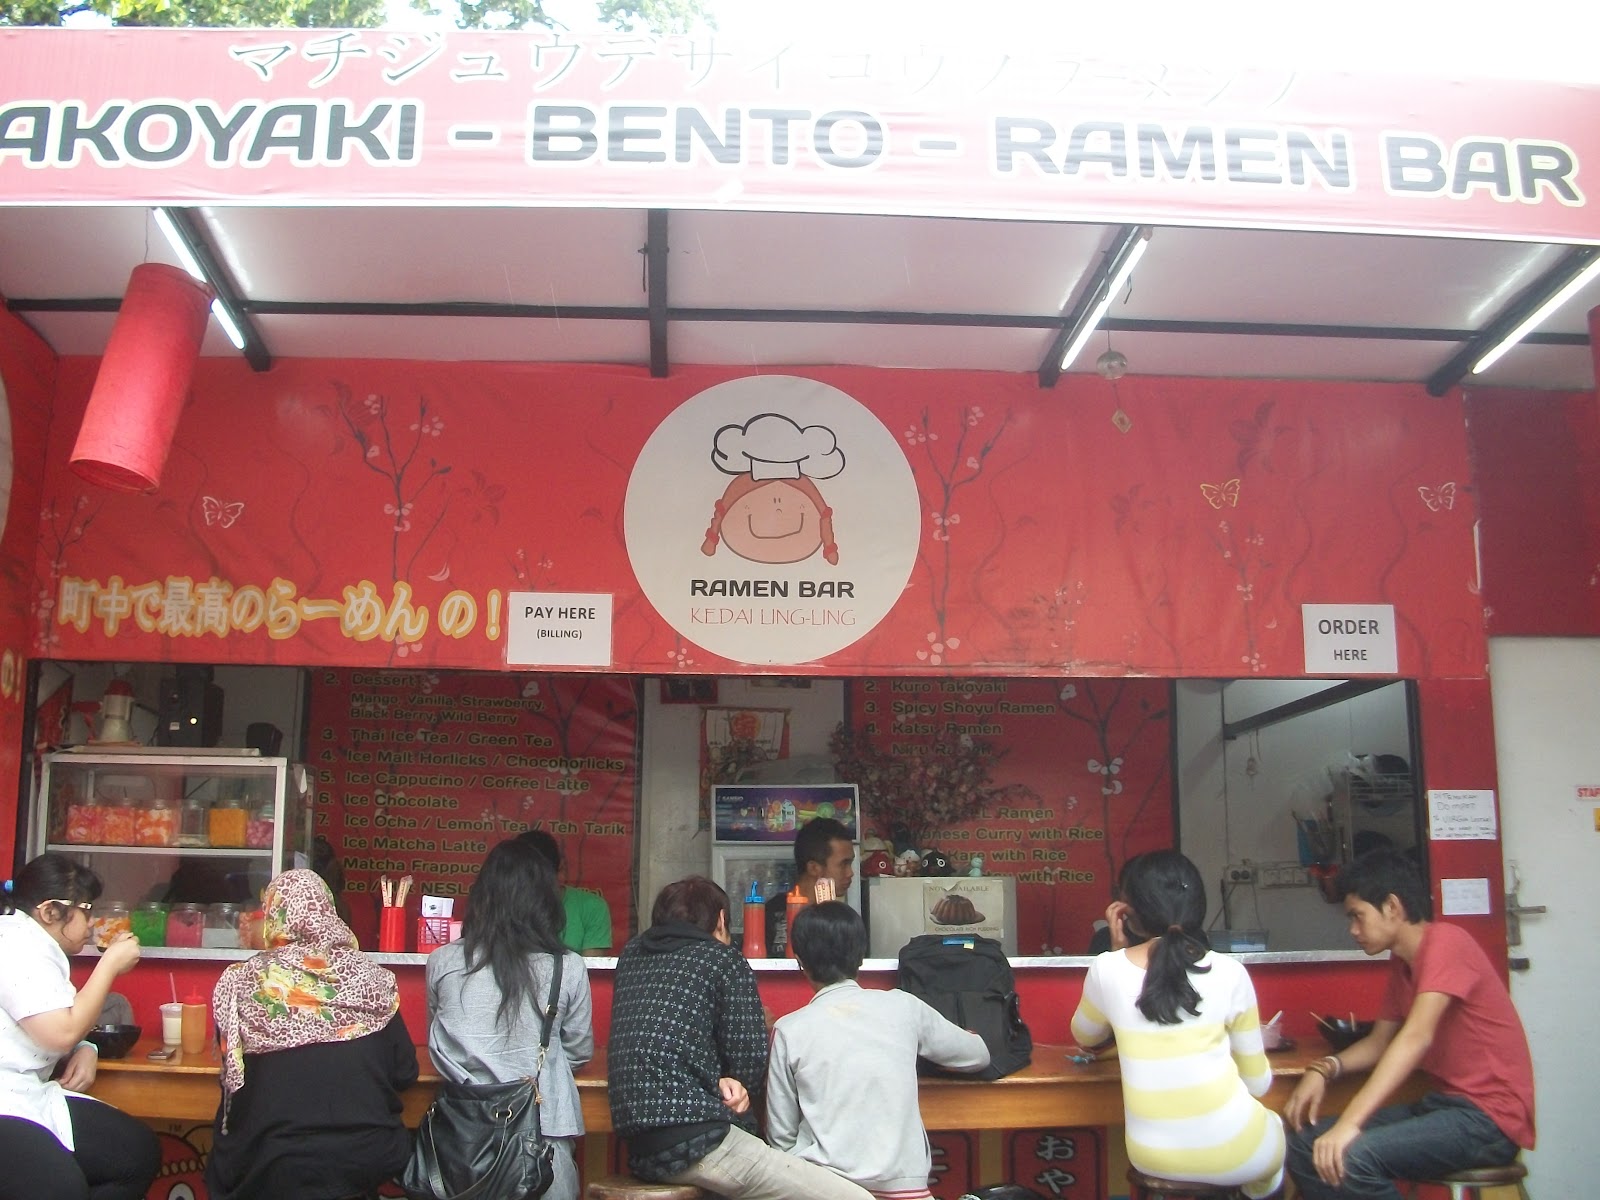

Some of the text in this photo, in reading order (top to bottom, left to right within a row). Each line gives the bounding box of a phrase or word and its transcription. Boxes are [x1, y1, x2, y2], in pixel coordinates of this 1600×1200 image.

[532, 105, 883, 168] BENTO
[994, 116, 1351, 190] RAMEN
[1387, 136, 1579, 202] BAR
[691, 579, 855, 599] RAMEN BAR
[525, 606, 596, 620] PAY HERE
[691, 608, 857, 626] KEDAI LING-LING
[536, 629, 583, 641] (BILLING)
[1318, 619, 1380, 635] ORDER
[1333, 649, 1368, 661] HERE
[325, 673, 339, 685] 2.
[352, 672, 417, 686] Dessert
[865, 680, 1008, 696] 2. Kuro Takoyaki
[463, 696, 545, 711] Strawberry,
[865, 702, 1056, 716] 3. Spicy Shoyu Ramen
[351, 708, 389, 719] Black
[442, 711, 473, 722] Wild
[477, 711, 518, 726] Berry
[865, 723, 881, 735] 4.
[945, 722, 1003, 735] Ramen
[322, 728, 337, 741] 3.
[351, 728, 385, 742] Thai
[391, 729, 415, 743] Ice
[420, 730, 449, 744] Tea
[468, 732, 518, 746] Green
[524, 734, 553, 747] Tea
[321, 749, 336, 761] 4.
[347, 750, 372, 763] Ice
[377, 750, 414, 764] Malt
[419, 752, 487, 767] Horlicks
[505, 754, 625, 771] Chocohorlicks
[320, 771, 335, 784] 5.
[346, 771, 370, 785] Ice
[376, 772, 464, 788] Cappucino
[482, 776, 540, 789] Coffee
[545, 777, 590, 791] Latte
[319, 792, 459, 809] 6. Ice Chocolate
[1000, 806, 1055, 820] Ramen
[317, 813, 329, 826] 7.
[344, 814, 369, 828] Ice
[374, 814, 418, 829] Ocha
[436, 817, 494, 831] Lemon
[501, 819, 529, 832] Tea
[549, 820, 578, 834] Teh
[584, 821, 625, 835] Tarik
[976, 828, 1023, 843] Curry
[1028, 828, 1063, 841] with
[1068, 828, 1104, 841] Rice
[344, 836, 368, 849] Ice
[374, 837, 436, 851] Matcha
[442, 839, 487, 853] Latte
[950, 849, 1067, 863] Kare with Rice
[344, 857, 483, 875] Matcha Frappuc
[1019, 870, 1053, 883] with
[1058, 870, 1094, 883] Rice
[345, 879, 367, 892] Ice
